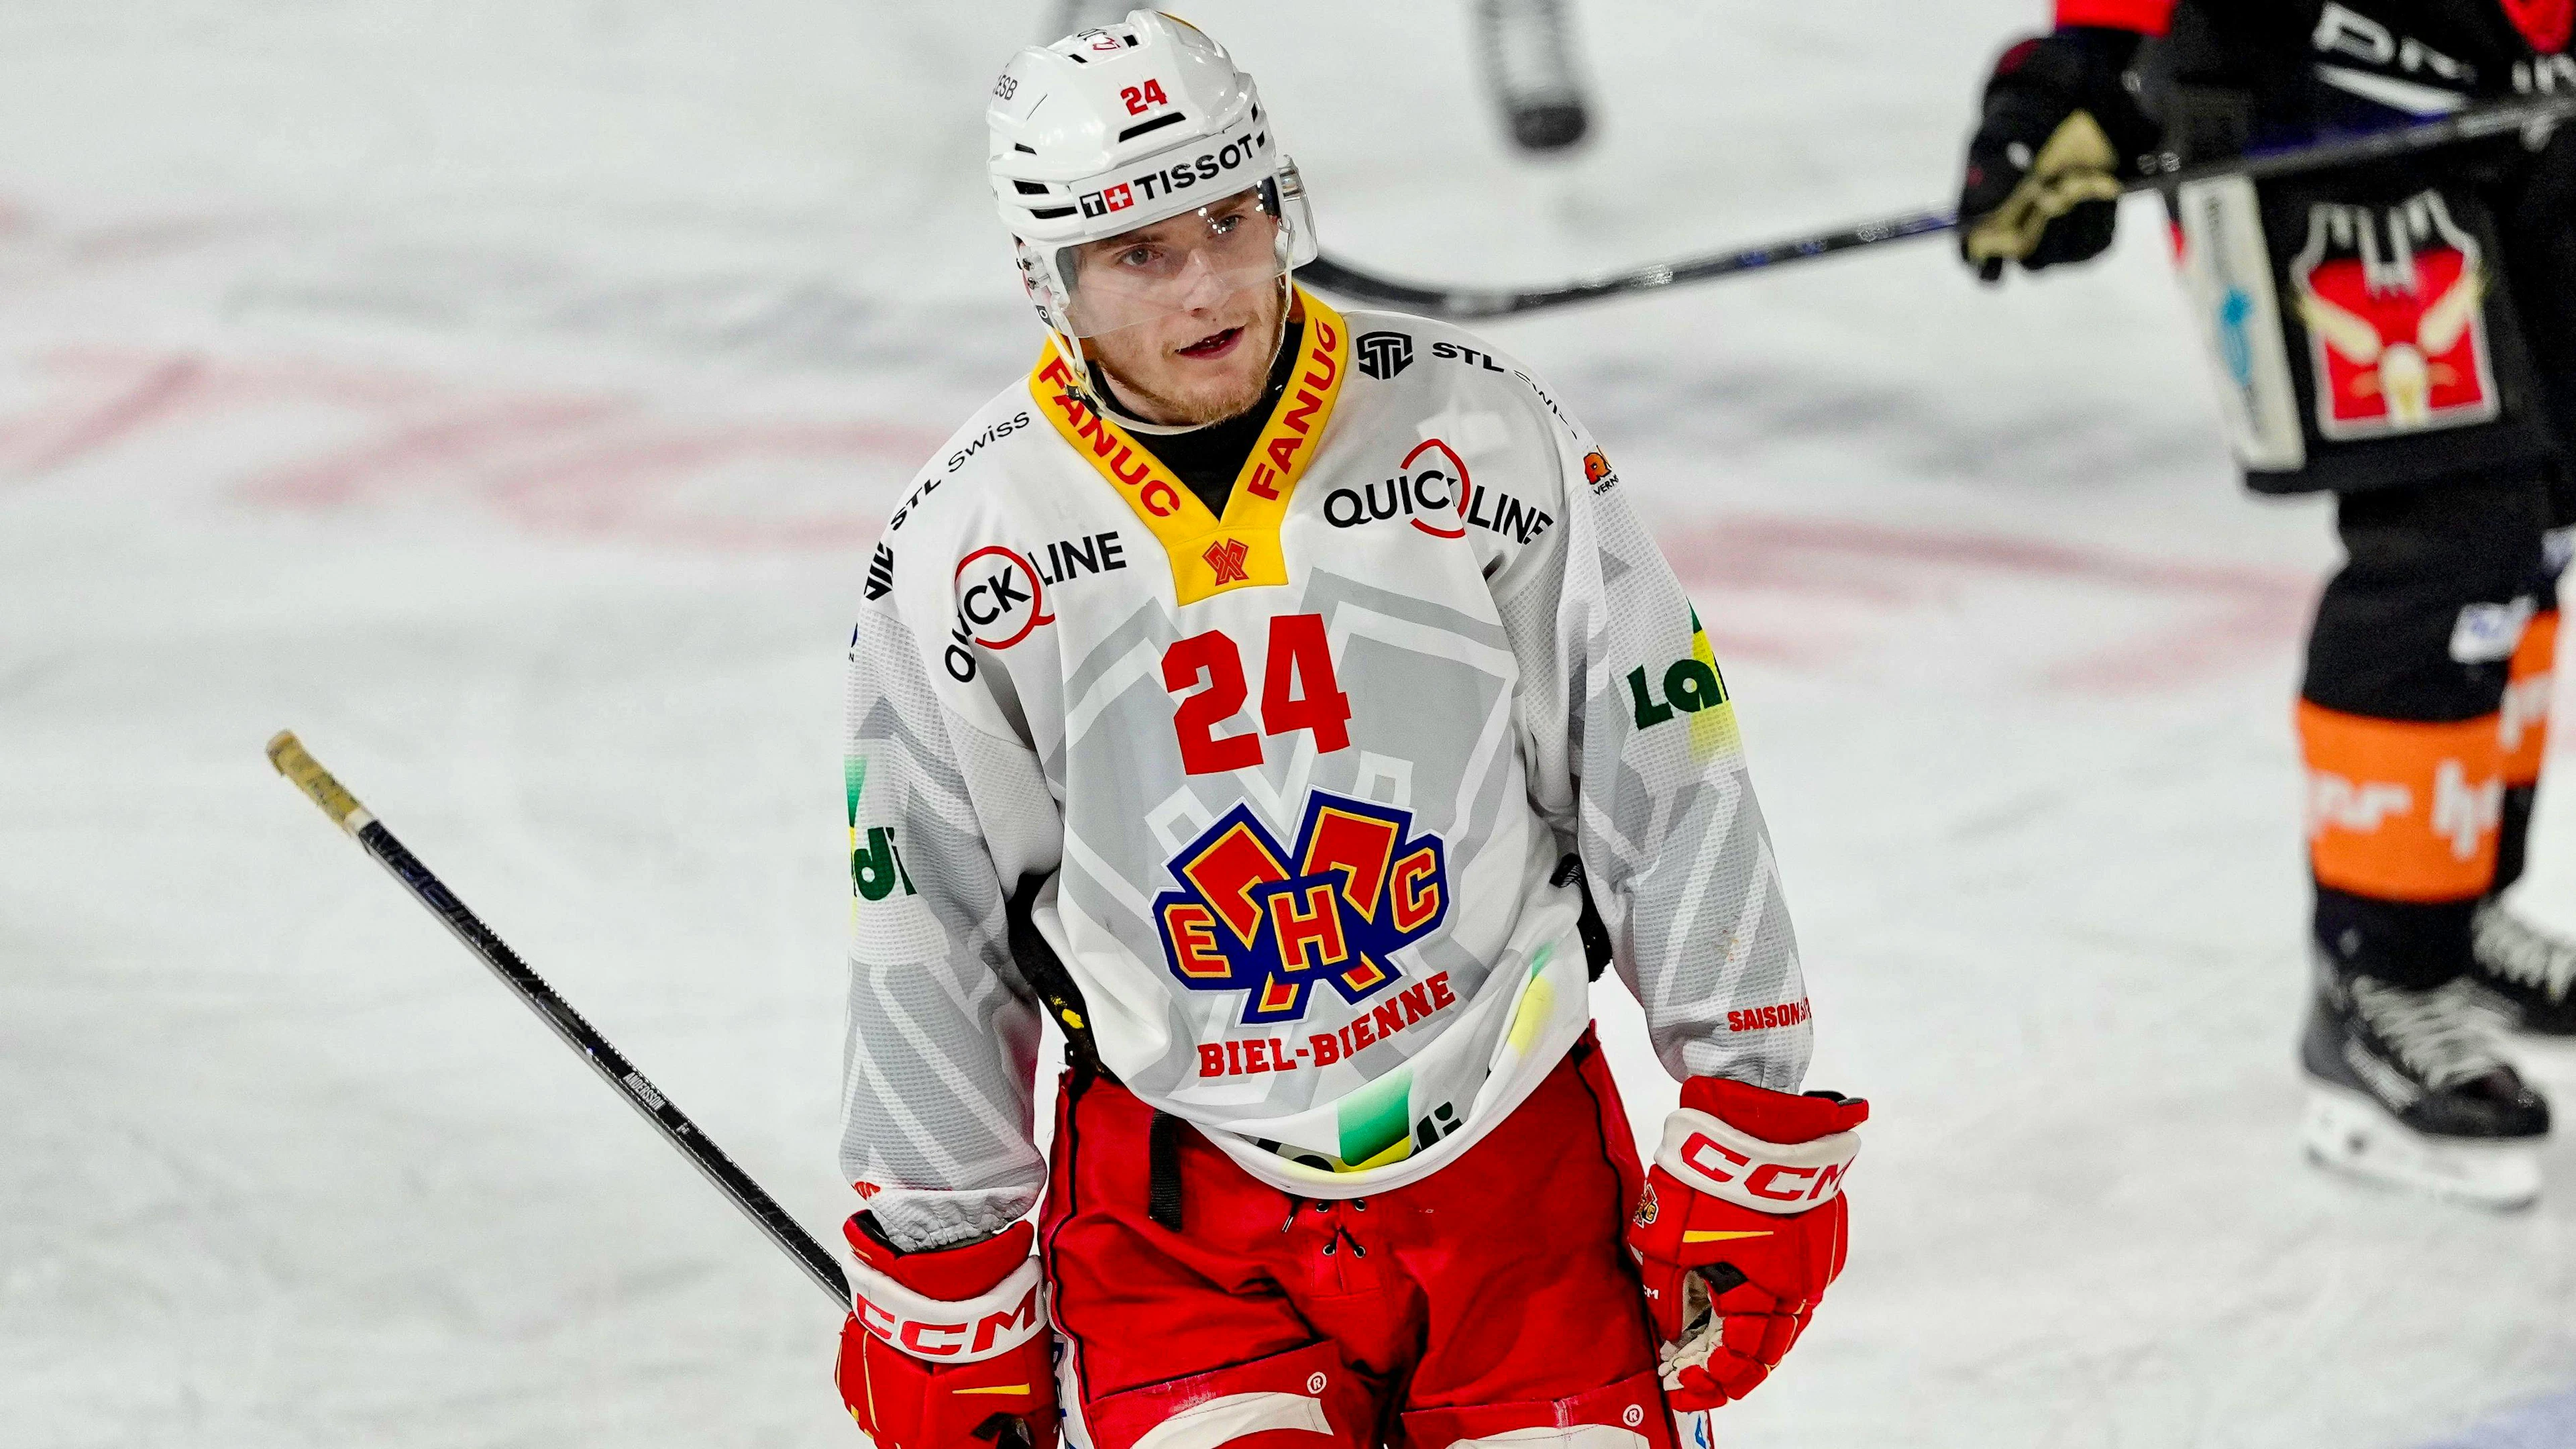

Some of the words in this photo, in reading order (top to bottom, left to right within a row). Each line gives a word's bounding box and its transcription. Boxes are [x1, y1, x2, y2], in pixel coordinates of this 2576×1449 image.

[1120, 78, 1168, 116] 24
[1134, 133, 1256, 200] TISSOT
[1432, 342, 1504, 373] STL
[890, 479, 941, 531] STL
[948, 412, 1030, 472] Swiss
[1038, 356, 1181, 517] FANUC
[1324, 470, 1554, 545] QUICLINE
[1161, 613, 1352, 775] 24
[1626, 651, 1729, 731] La
[1164, 847, 1440, 978] EHC
[1198, 971, 1456, 1078] BIEL-BIENNE
[623, 1071, 666, 1112] ANDERSSON
[1680, 1132, 1855, 1201] CCM
[857, 1281, 1038, 1355] CCM
